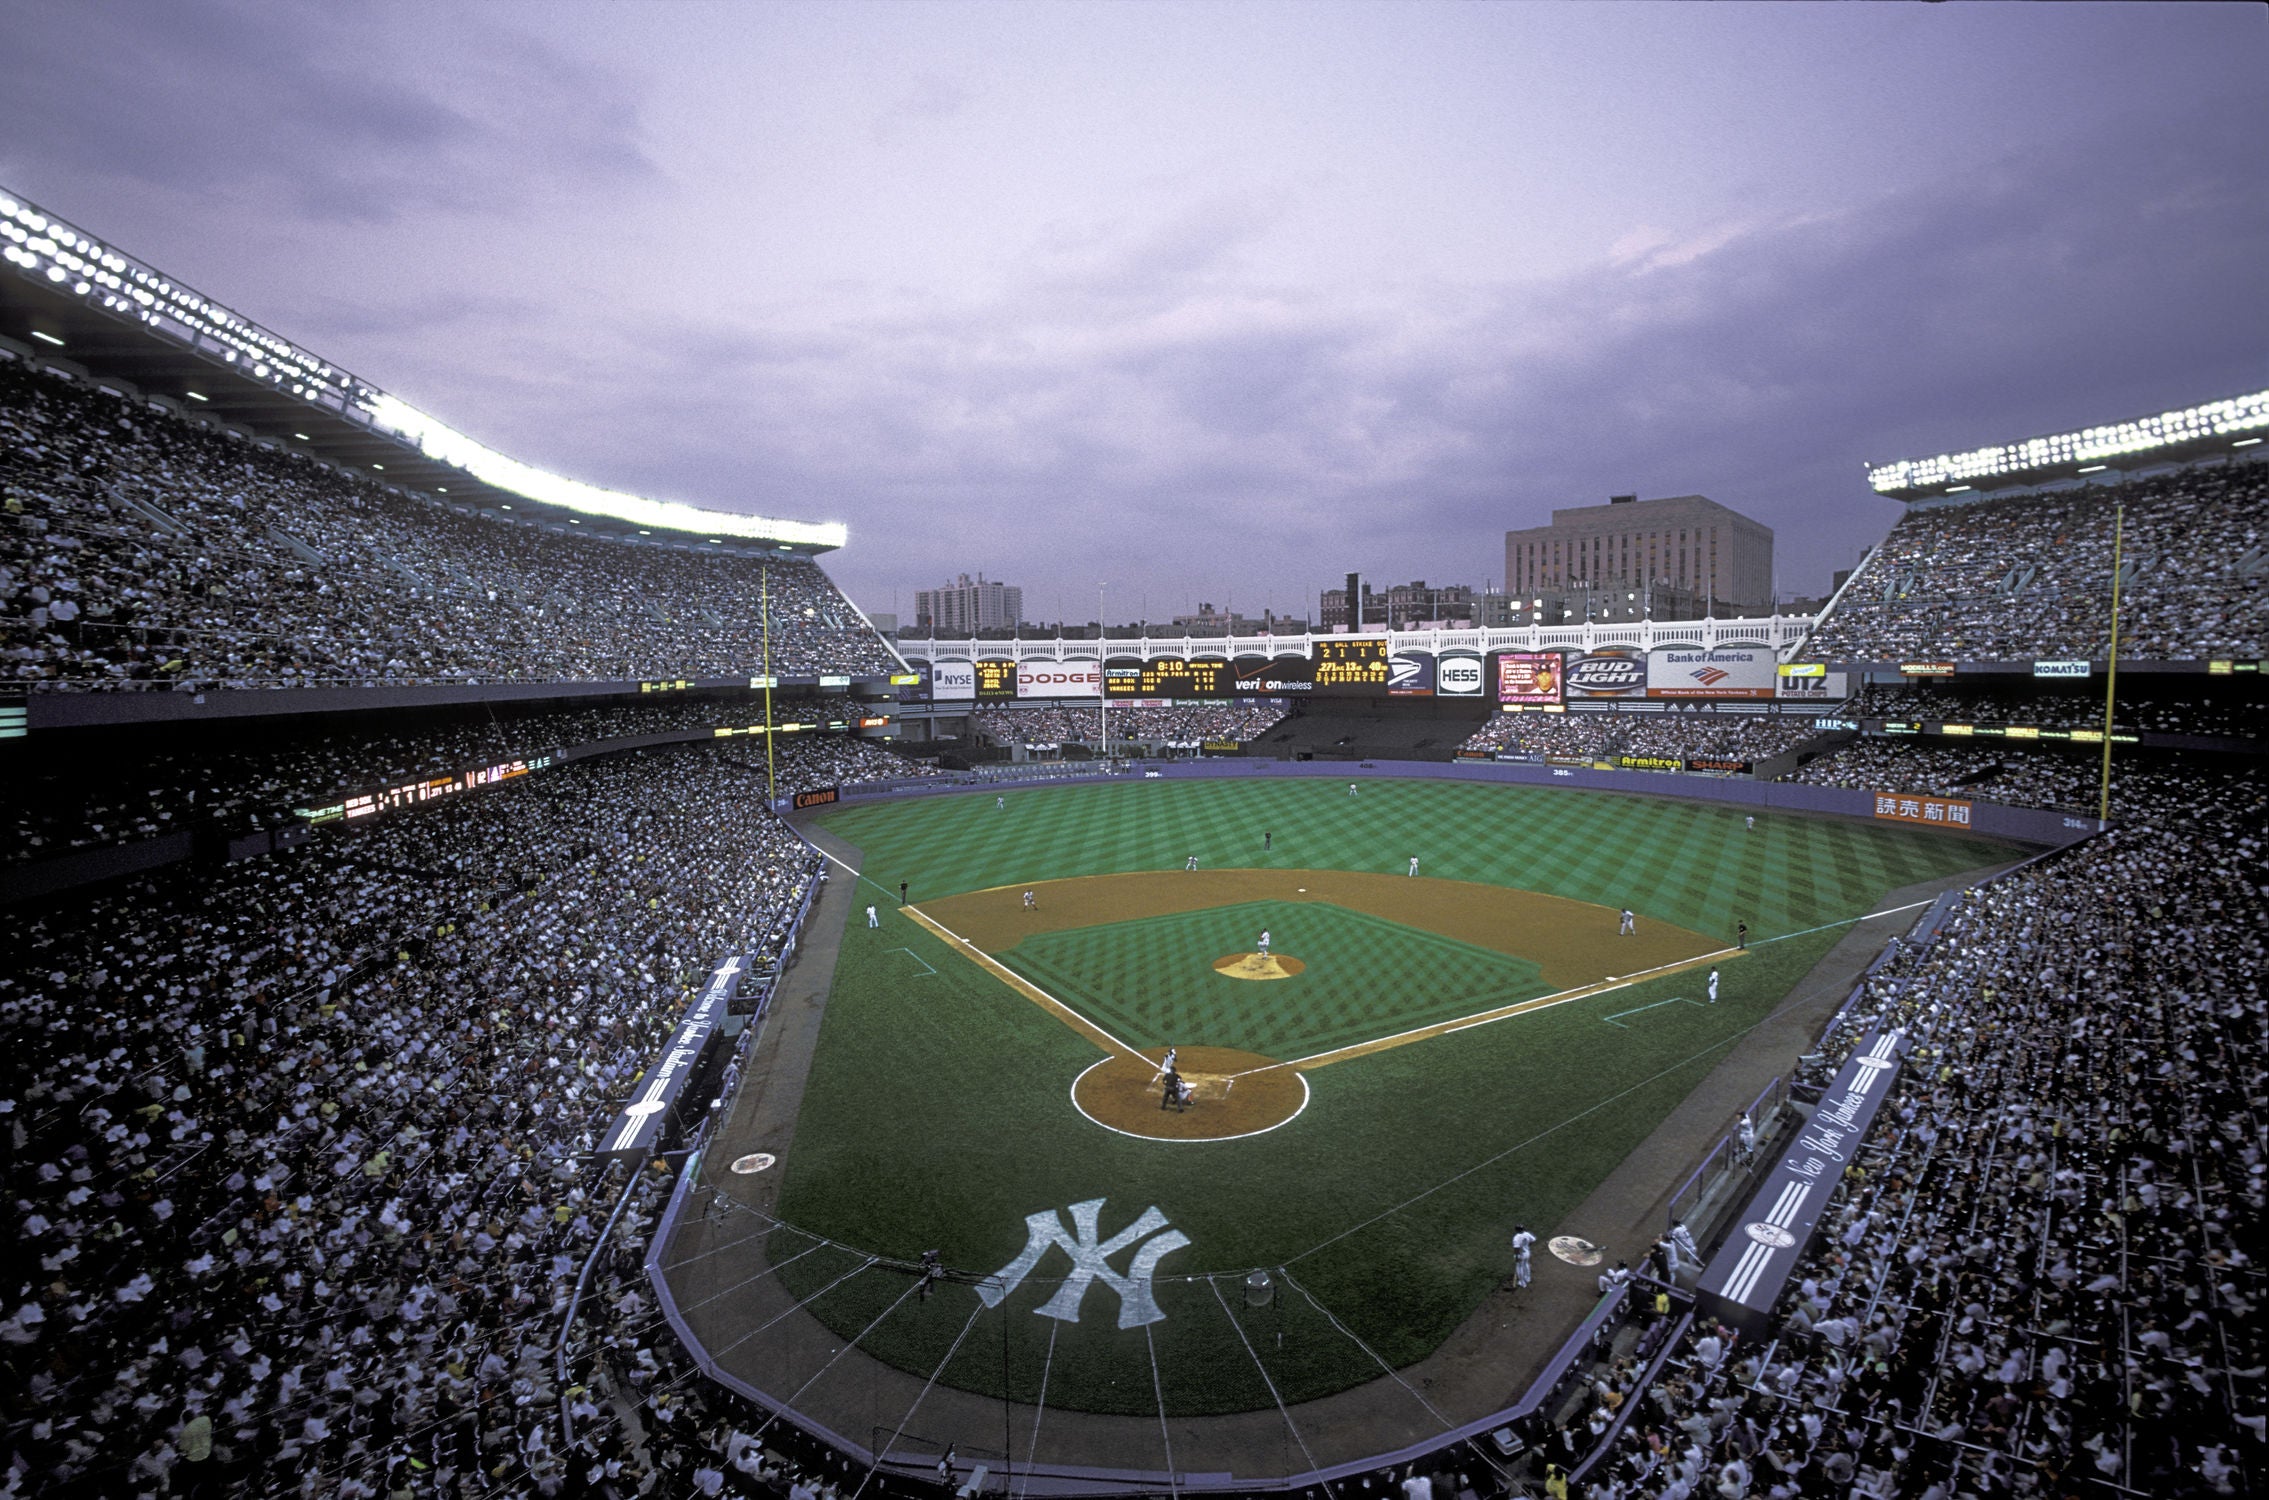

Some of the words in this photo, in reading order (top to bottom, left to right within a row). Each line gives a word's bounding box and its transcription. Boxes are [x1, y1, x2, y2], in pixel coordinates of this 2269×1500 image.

[1323, 648, 1331, 658] 2
[1339, 648, 1345, 658] 1
[1360, 647, 1366, 657] 1
[1379, 646, 1386, 657] 0
[1667, 653, 1694, 663] Bank
[1694, 653, 1707, 663] of
[1707, 652, 1753, 662] America
[1157, 661, 1183, 671] 8:10
[1318, 662, 1336, 672] .271
[1345, 661, 1357, 672] 13
[1579, 661, 1635, 673] BUD
[1018, 673, 1101, 684] DODGE
[1106, 669, 1139, 677] Armitron
[1442, 669, 1479, 682] HESS
[1569, 672, 1644, 683] LIGHT
[944, 674, 972, 685] NYSE
[1235, 677, 1281, 692] verizon
[1281, 680, 1312, 690] wireless
[1815, 719, 1842, 727] HIP
[1621, 756, 1682, 767] Armitron
[1692, 760, 1743, 769] SHARP
[796, 790, 835, 808] Canon
[1876, 796, 1970, 825] 読売新聞
[2063, 817, 2081, 828] 314
[1817, 1091, 1866, 1134] Yankees
[1799, 1123, 1845, 1162] York
[1785, 1157, 1826, 1187] New
[973, 1197, 1192, 1330] NY
